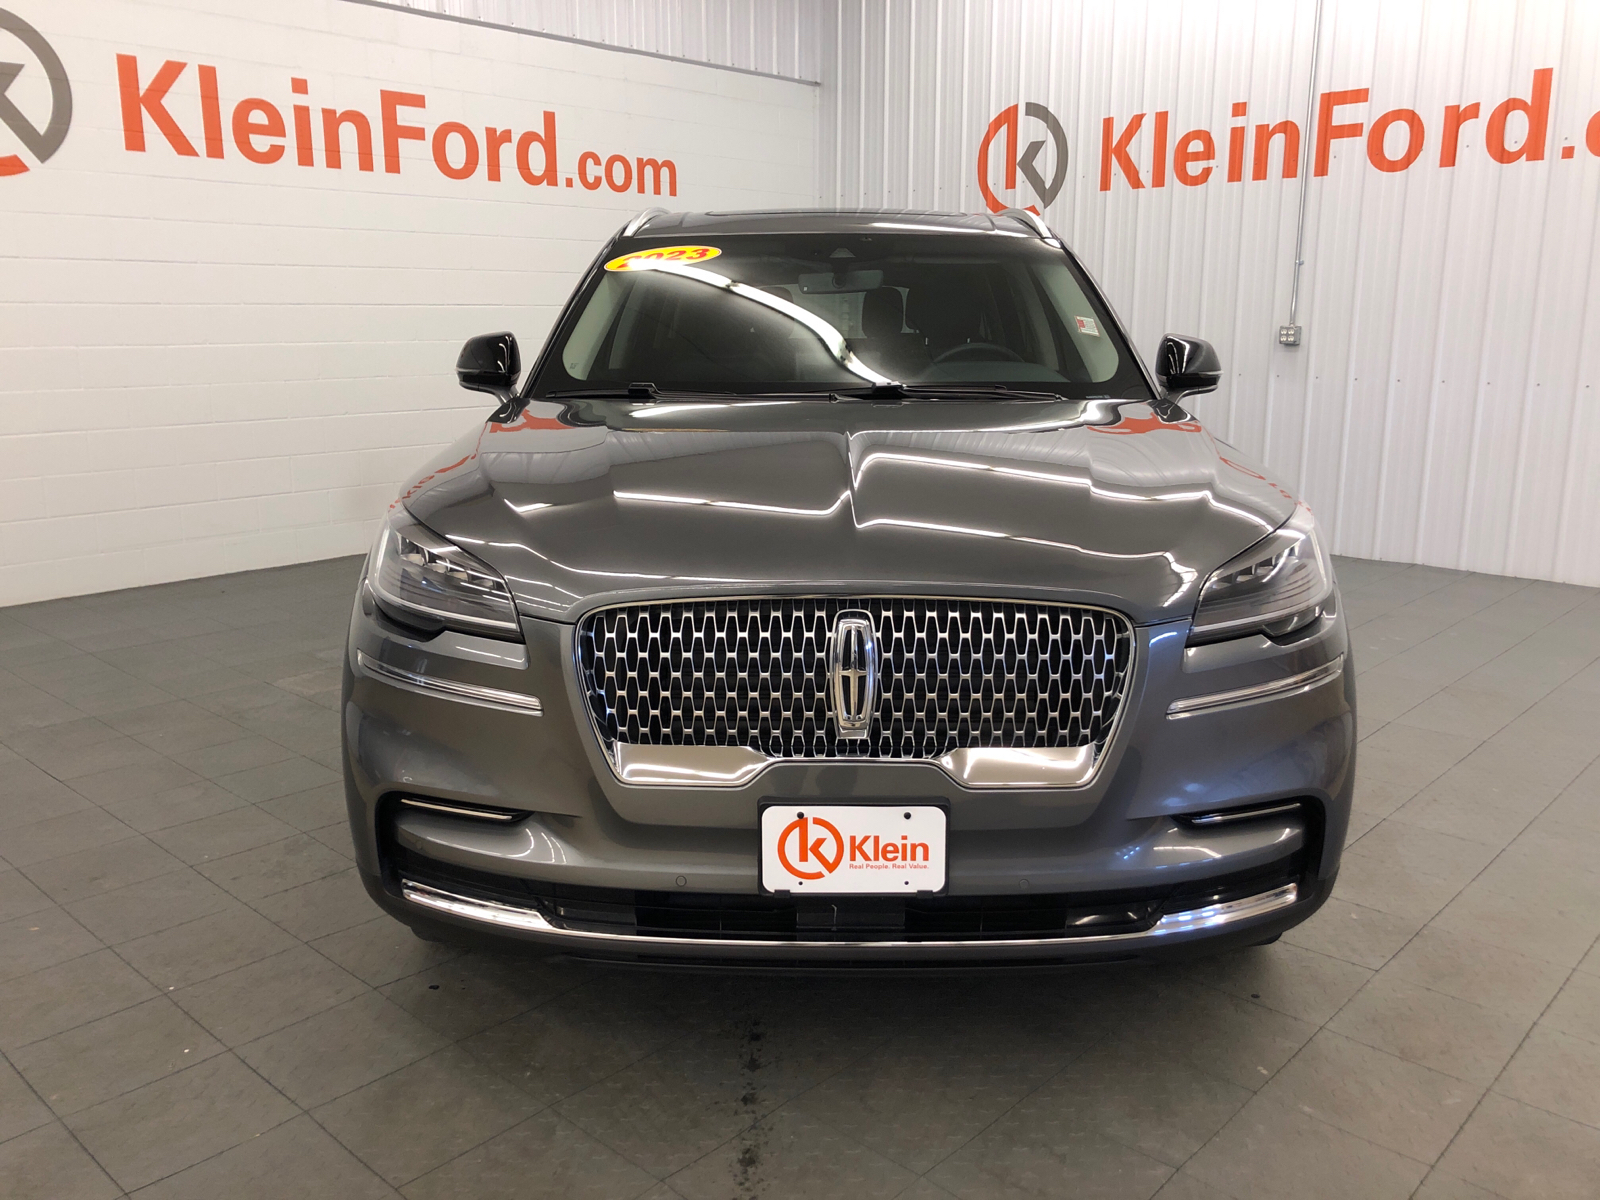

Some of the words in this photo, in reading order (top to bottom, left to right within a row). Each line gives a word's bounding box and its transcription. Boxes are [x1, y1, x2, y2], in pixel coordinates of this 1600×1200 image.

[116, 54, 677, 197] KleinFord.com
[849, 835, 930, 862] Klein
[865, 863, 890, 871] People.
